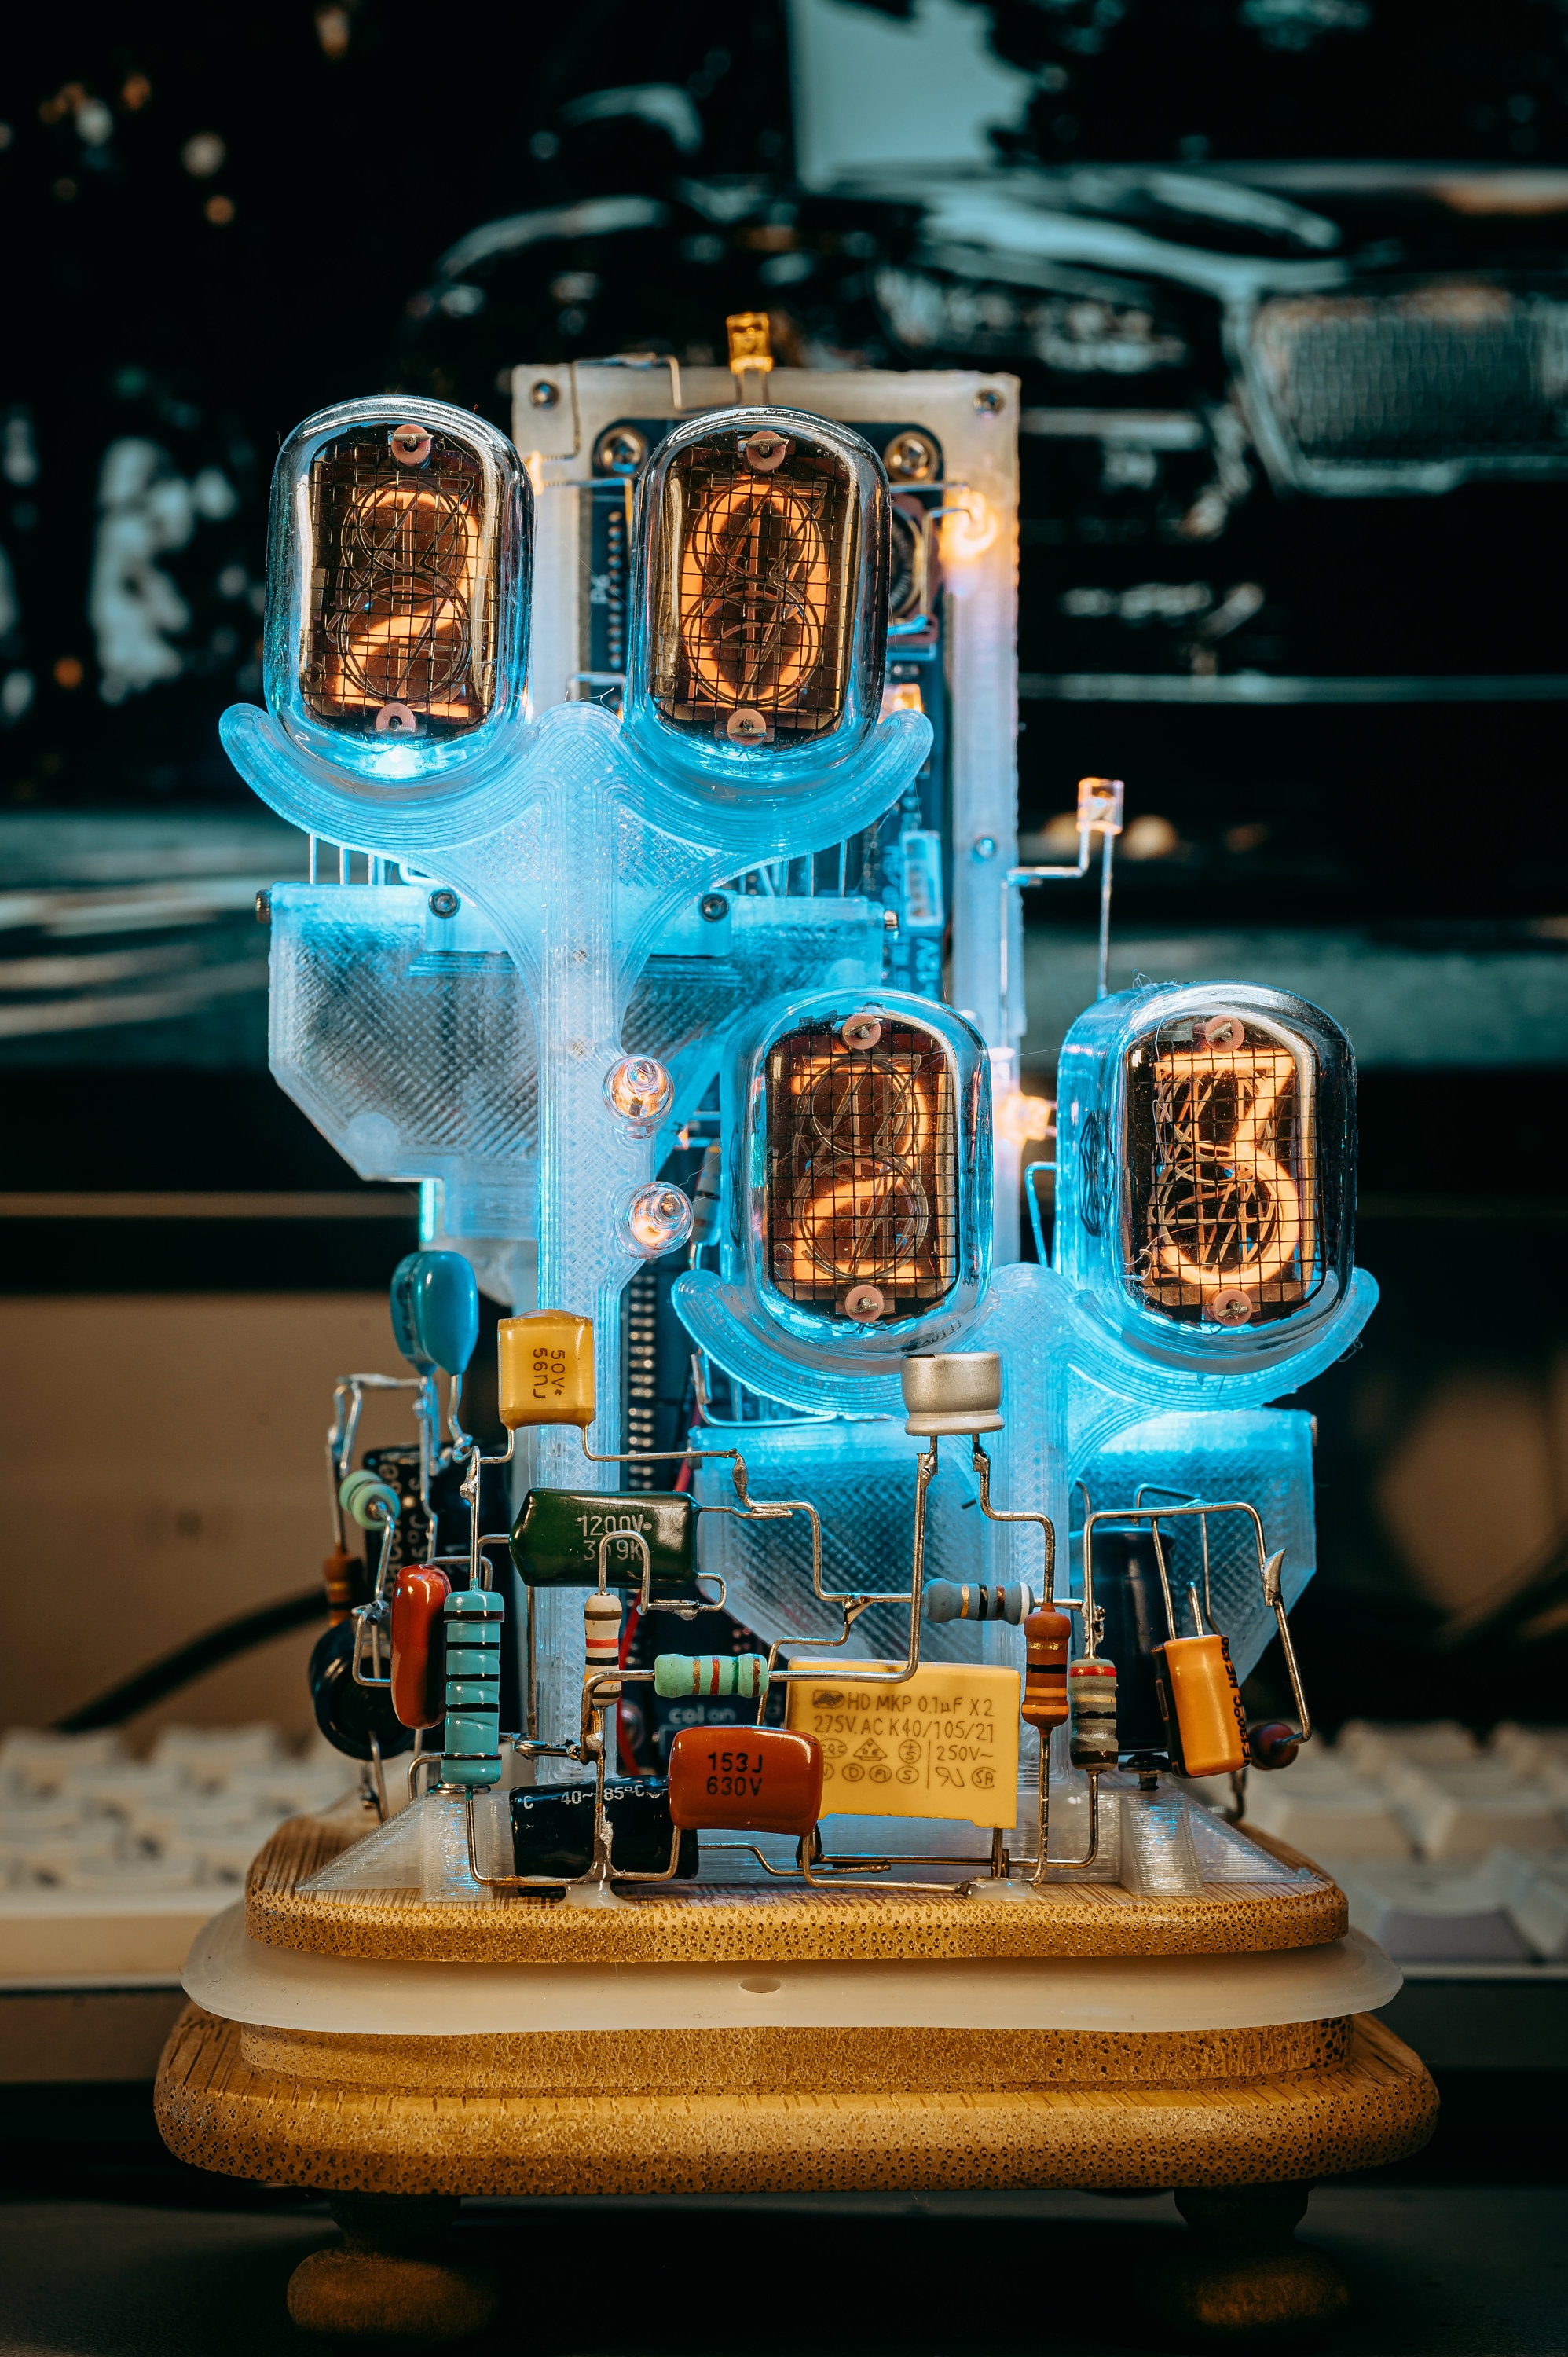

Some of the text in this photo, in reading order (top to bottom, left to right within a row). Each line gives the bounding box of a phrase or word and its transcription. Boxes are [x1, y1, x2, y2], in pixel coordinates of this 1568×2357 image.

[681, 482, 829, 709] 0
[876, 1695, 912, 1713] MKP
[708, 1752, 763, 1773] 153J
[706, 1776, 762, 1797] 630V
